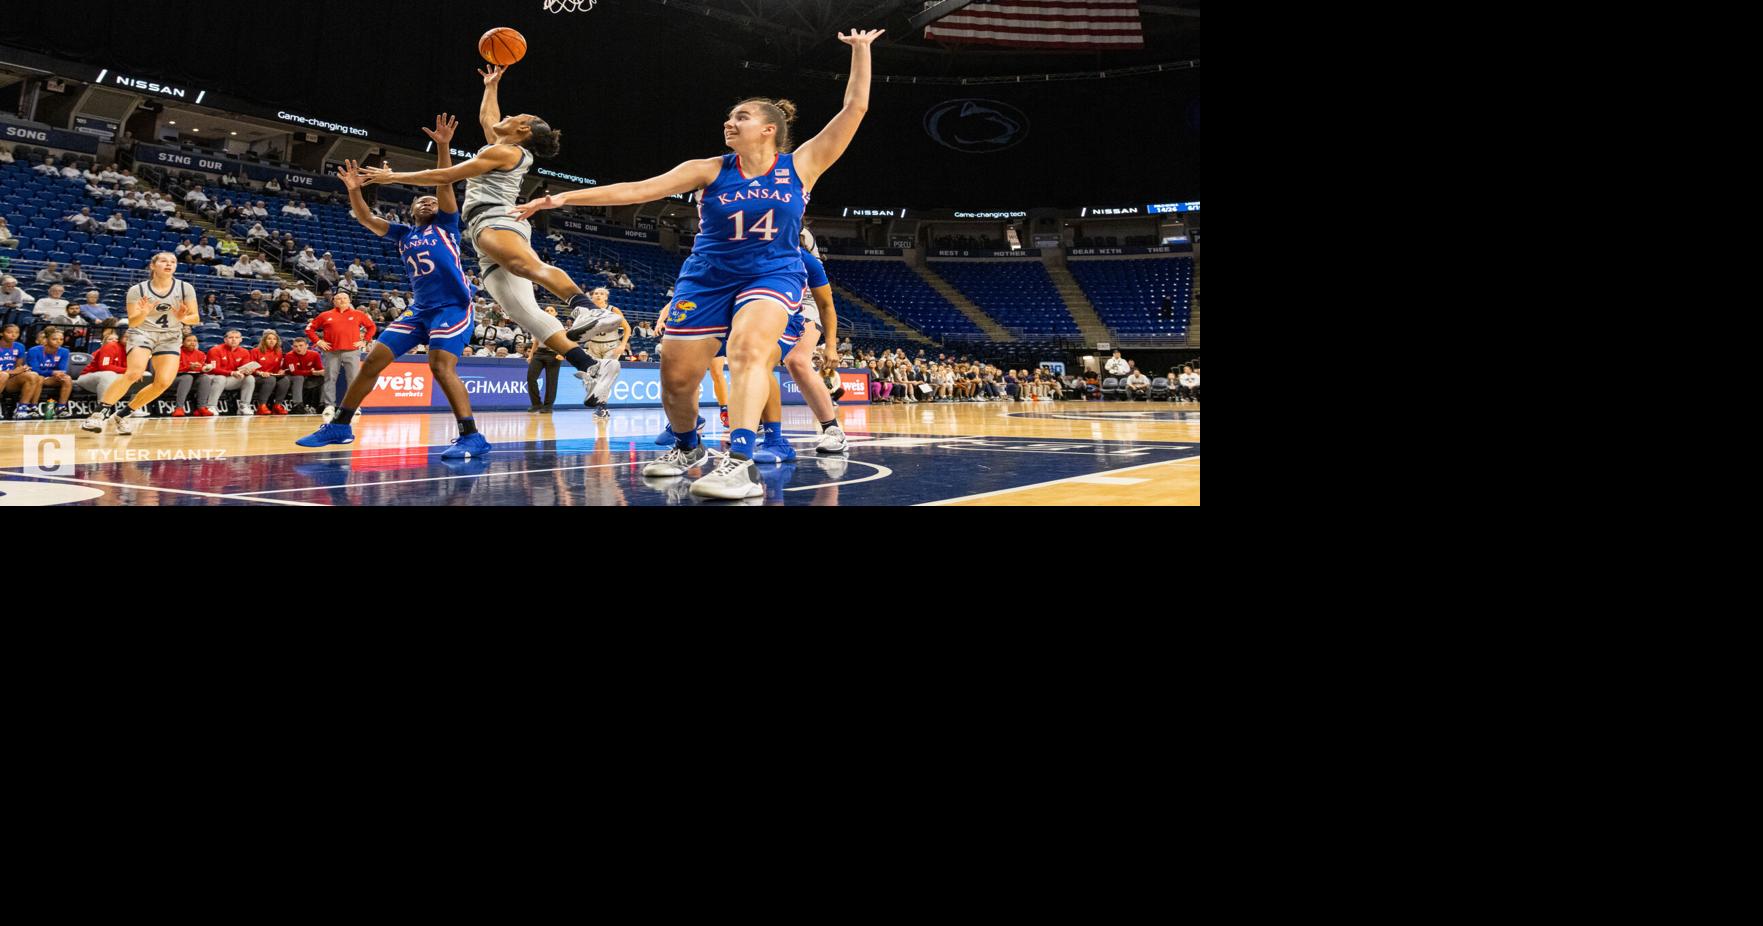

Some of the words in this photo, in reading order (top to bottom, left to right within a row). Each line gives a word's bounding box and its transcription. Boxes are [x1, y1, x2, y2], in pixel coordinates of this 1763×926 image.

[116, 75, 185, 98] NISSAN
[277, 111, 349, 134] Game-changing
[349, 126, 368, 137] tech
[158, 152, 191, 165] SING
[199, 159, 223, 171] OUR
[285, 173, 314, 186] LOVE
[537, 167, 583, 184] Game-changing
[583, 177, 597, 185] tech
[718, 188, 793, 206] KANSAS
[853, 209, 894, 217] NISSAN
[953, 211, 1009, 219] Game-changing
[1092, 207, 1138, 215] NISSAN
[564, 220, 582, 230] SING
[585, 224, 598, 232] OUR
[625, 230, 647, 239] HOPES
[727, 208, 779, 241] 14
[407, 250, 436, 277] 15
[155, 314, 169, 329] 4
[463, 380, 529, 394] GHMARK
[842, 380, 865, 391] weis
[68, 400, 97, 417] PSEC
[158, 400, 191, 414] PSEU
